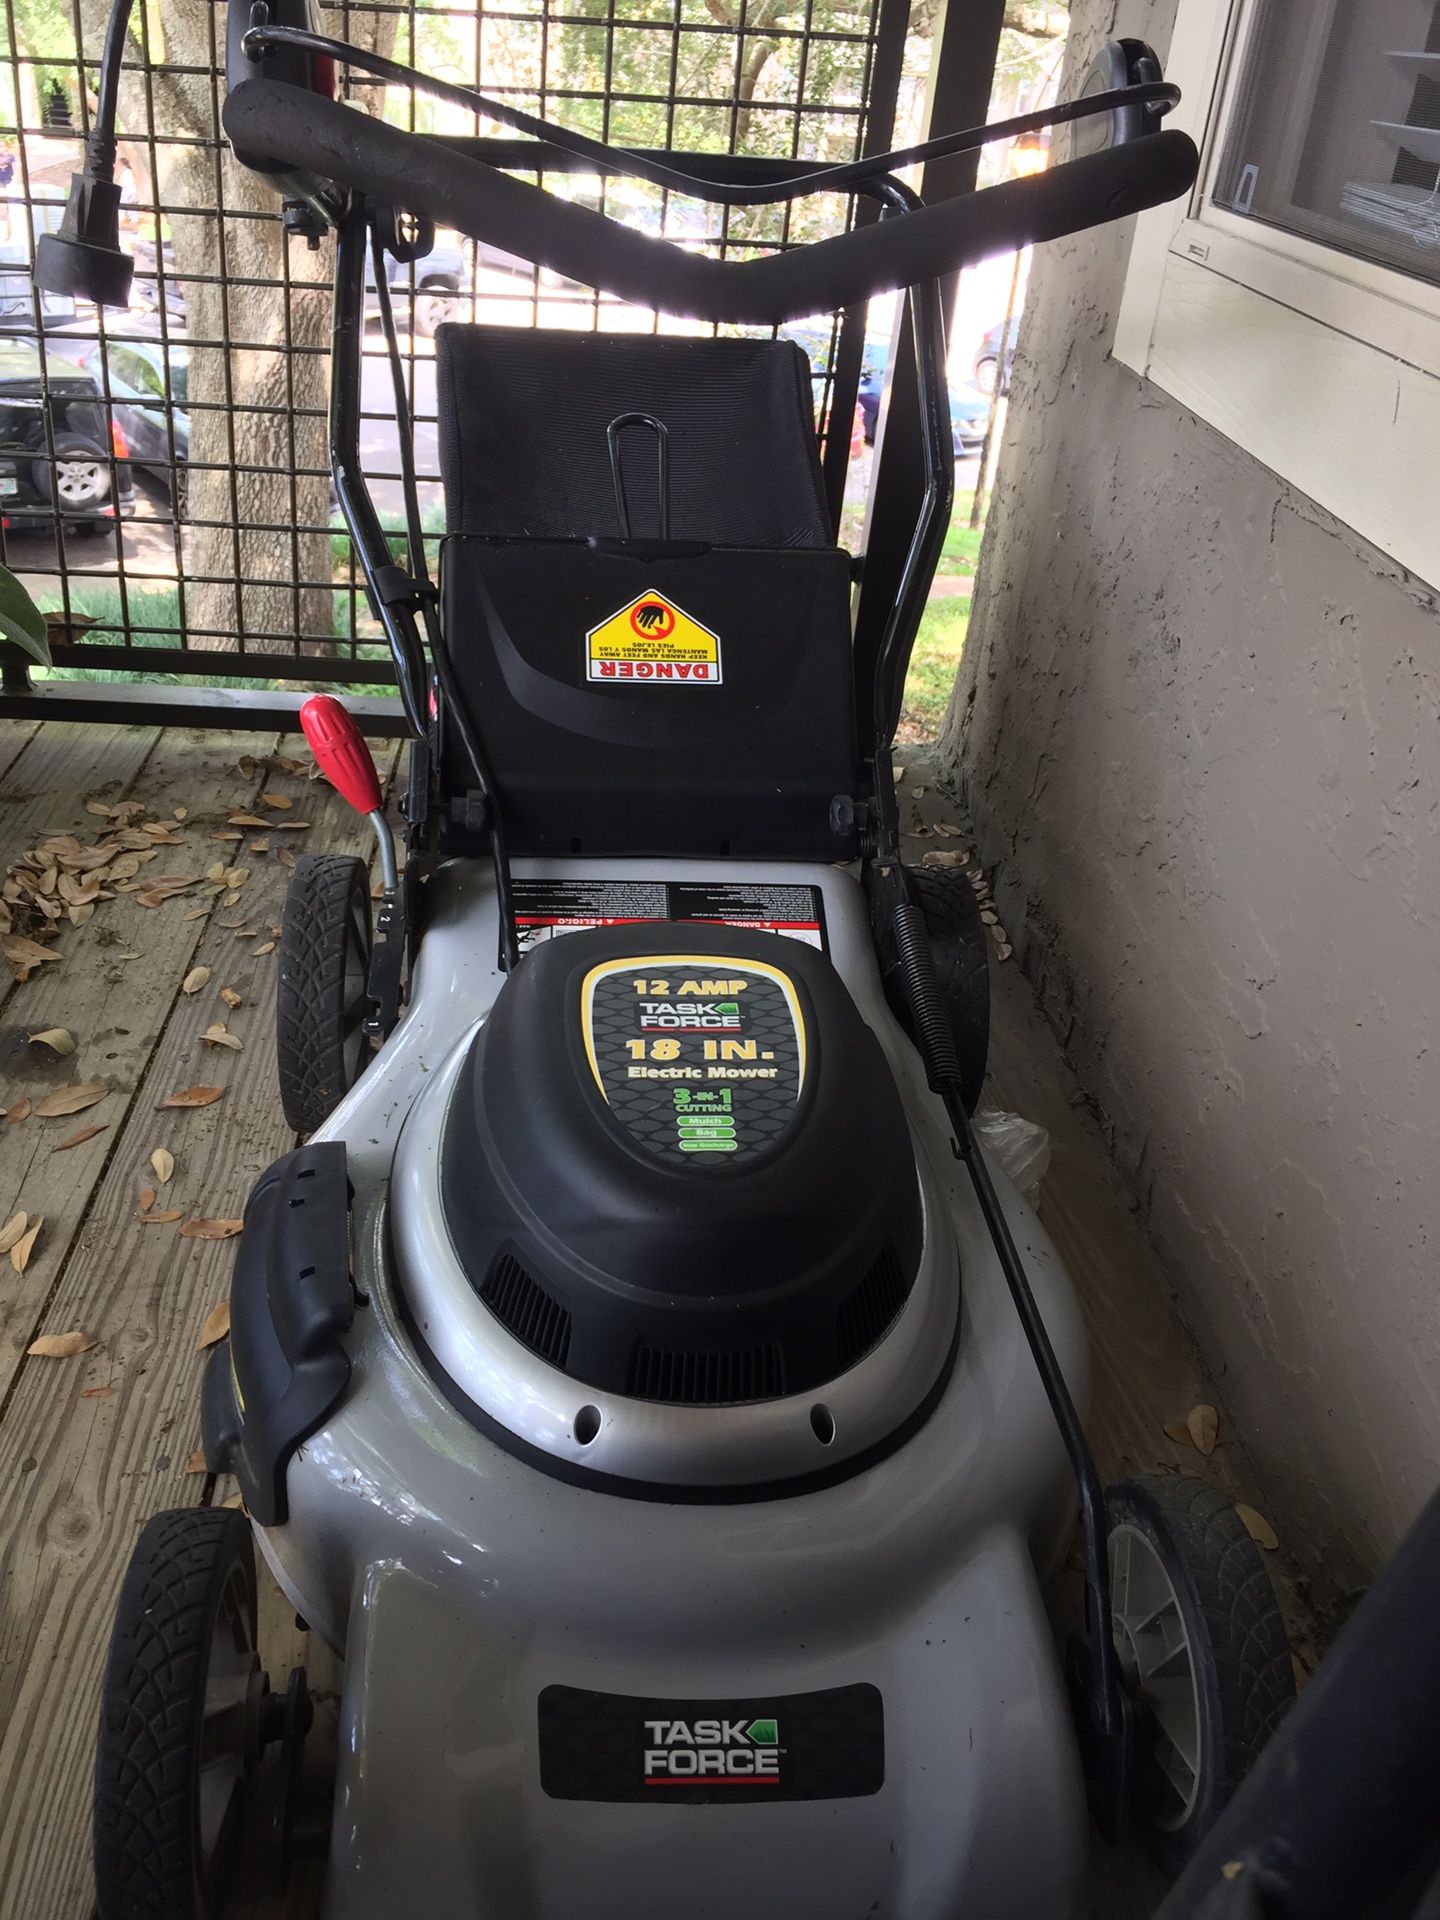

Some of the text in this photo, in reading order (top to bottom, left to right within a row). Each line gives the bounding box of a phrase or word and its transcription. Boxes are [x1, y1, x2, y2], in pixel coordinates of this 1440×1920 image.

[599, 661, 709, 679] DANGER
[633, 979, 748, 995] 12 AMP
[639, 1002, 717, 1015] TASK
[640, 1015, 742, 1028] FORCE
[626, 1038, 775, 1061] 18 IN.
[627, 1066, 779, 1079] Electric Mower
[673, 1087, 732, 1105] 3-IN-1
[675, 1104, 732, 1113] CUTTING
[695, 1129, 718, 1137] Bag
[644, 1719, 751, 1746] TASK
[644, 1748, 780, 1776] FORCE
